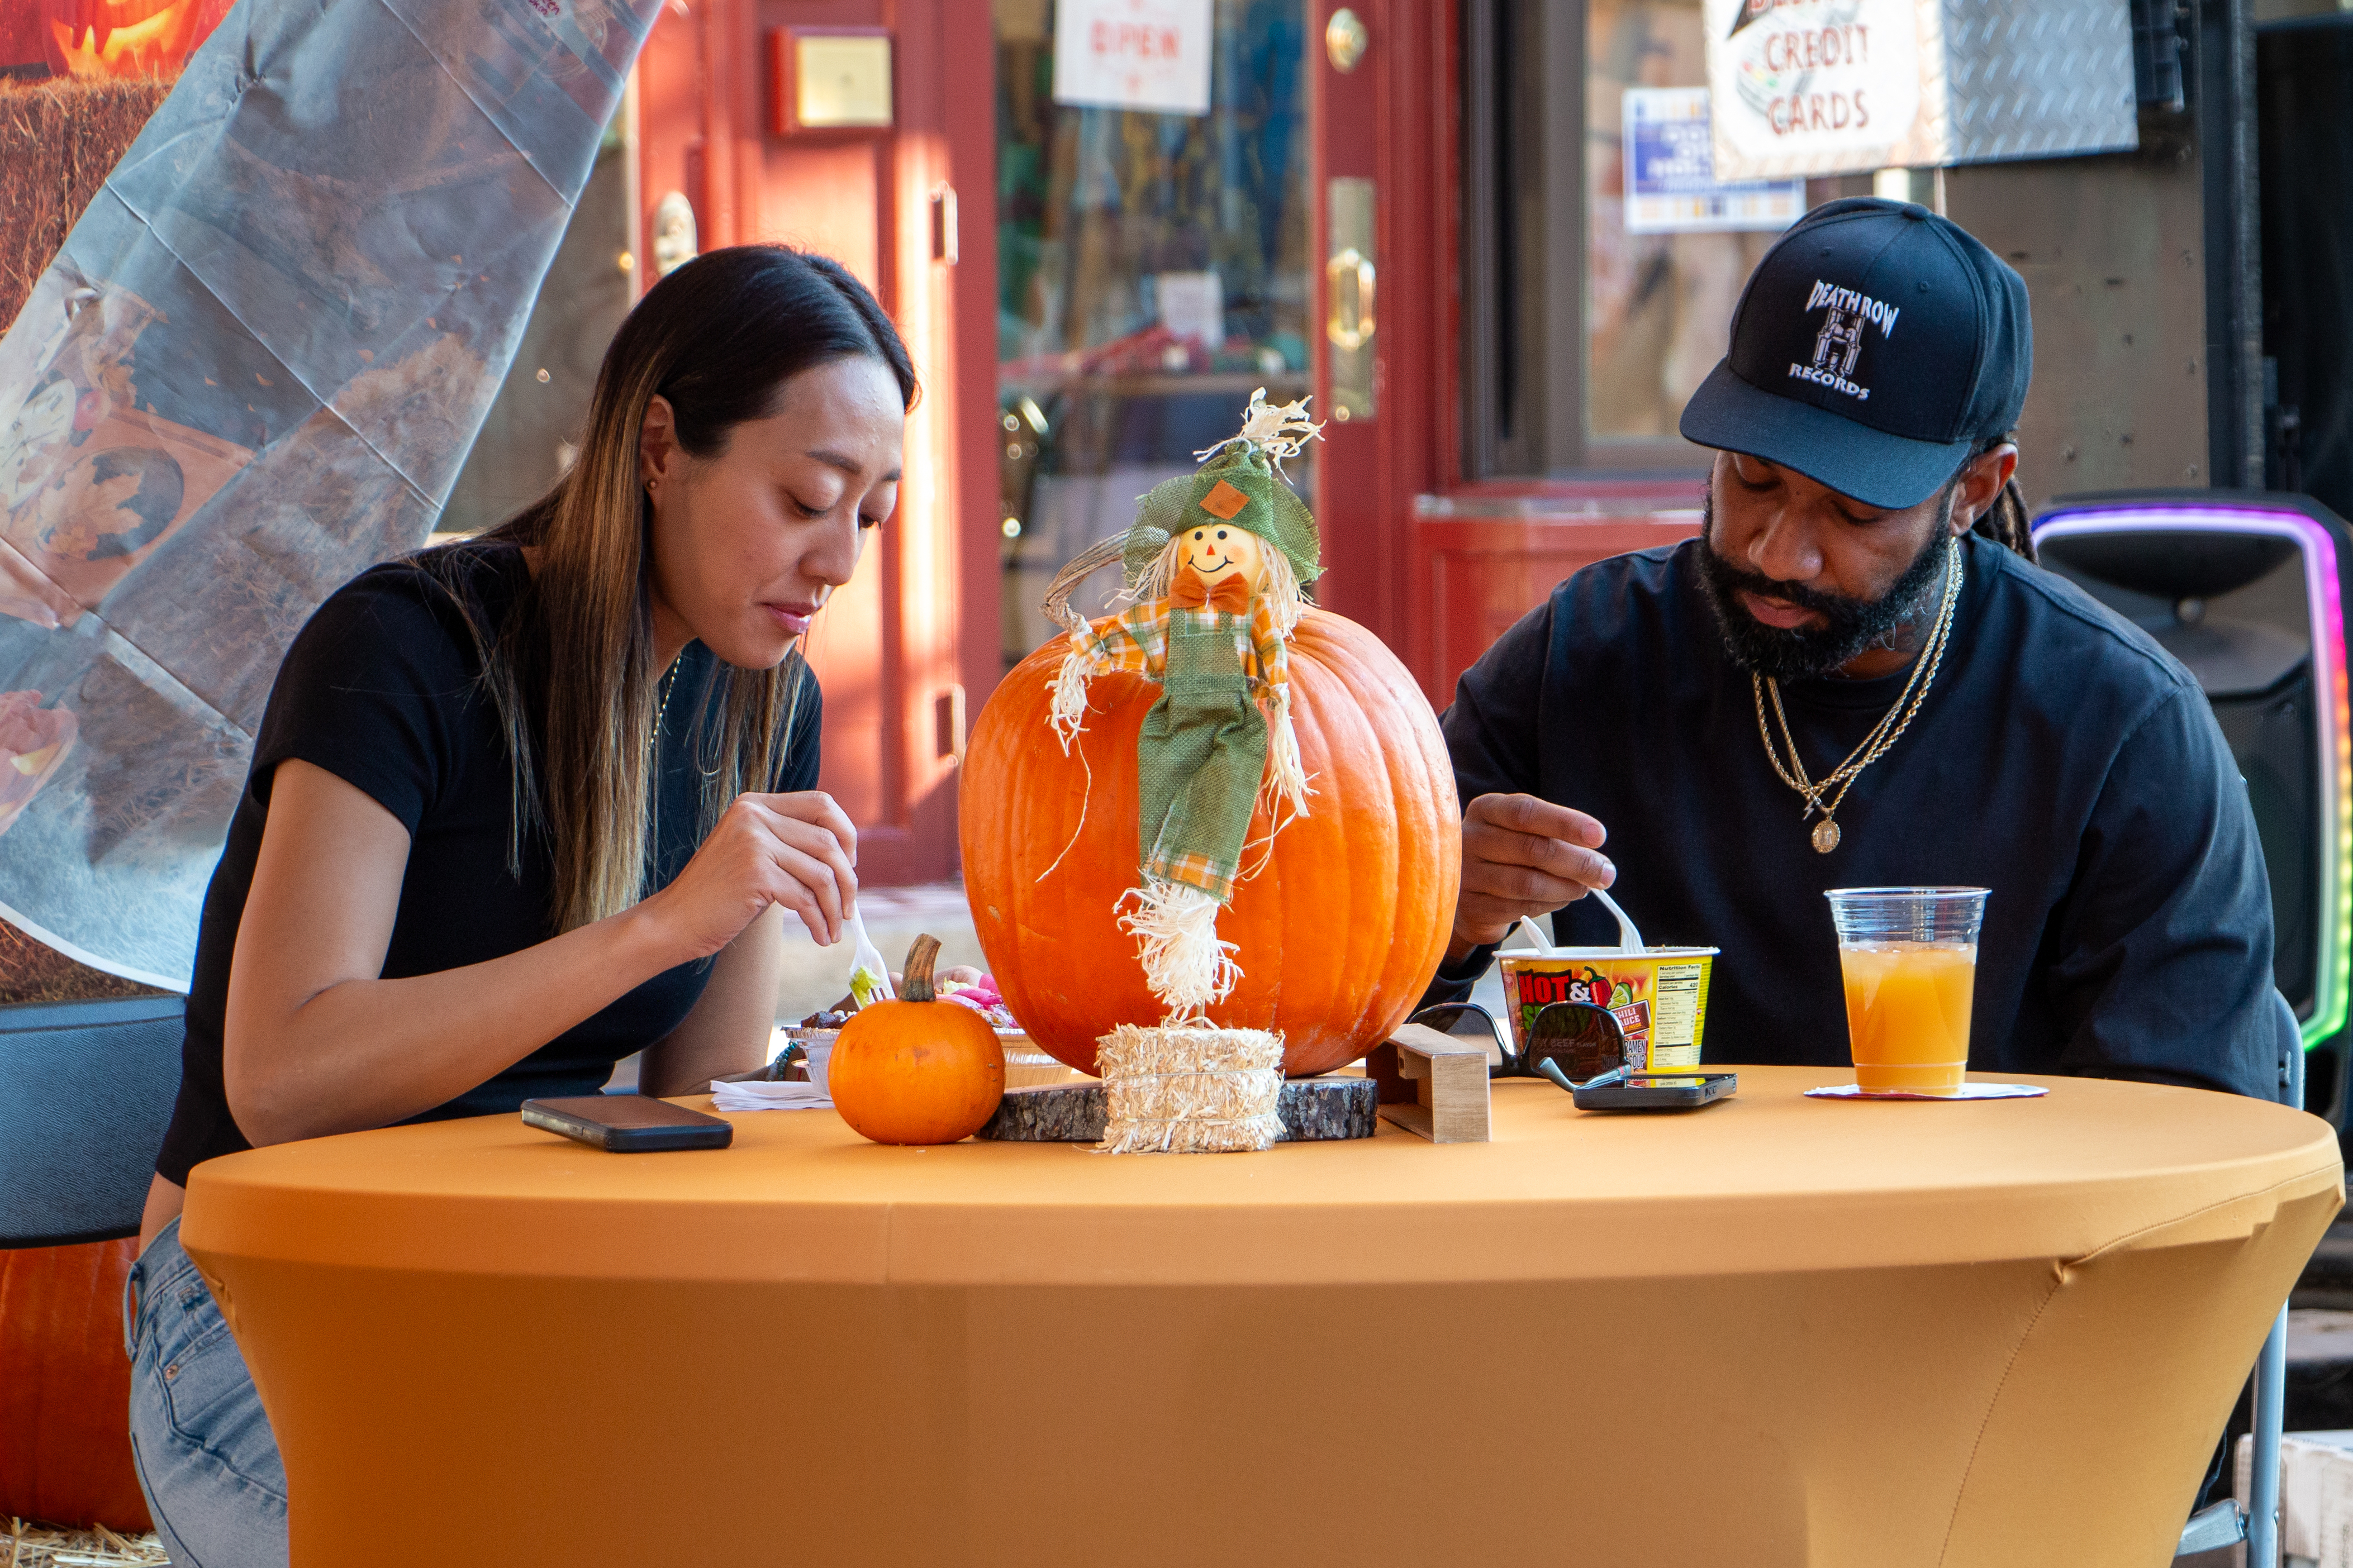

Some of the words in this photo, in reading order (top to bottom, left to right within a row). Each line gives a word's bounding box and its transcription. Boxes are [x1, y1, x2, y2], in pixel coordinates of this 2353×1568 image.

[1764, 24, 1869, 72] CREDIT
[1767, 89, 1869, 135] CARDS
[1789, 363, 1870, 401] RECORDS
[1519, 974, 1569, 1003] HOT
[1570, 982, 1591, 1001] &
[1614, 1008, 1636, 1018] HILI
[1620, 1015, 1641, 1027] AUCE
[1624, 1040, 1646, 1054] RAMEN
[1629, 1054, 1646, 1069] SOUP
